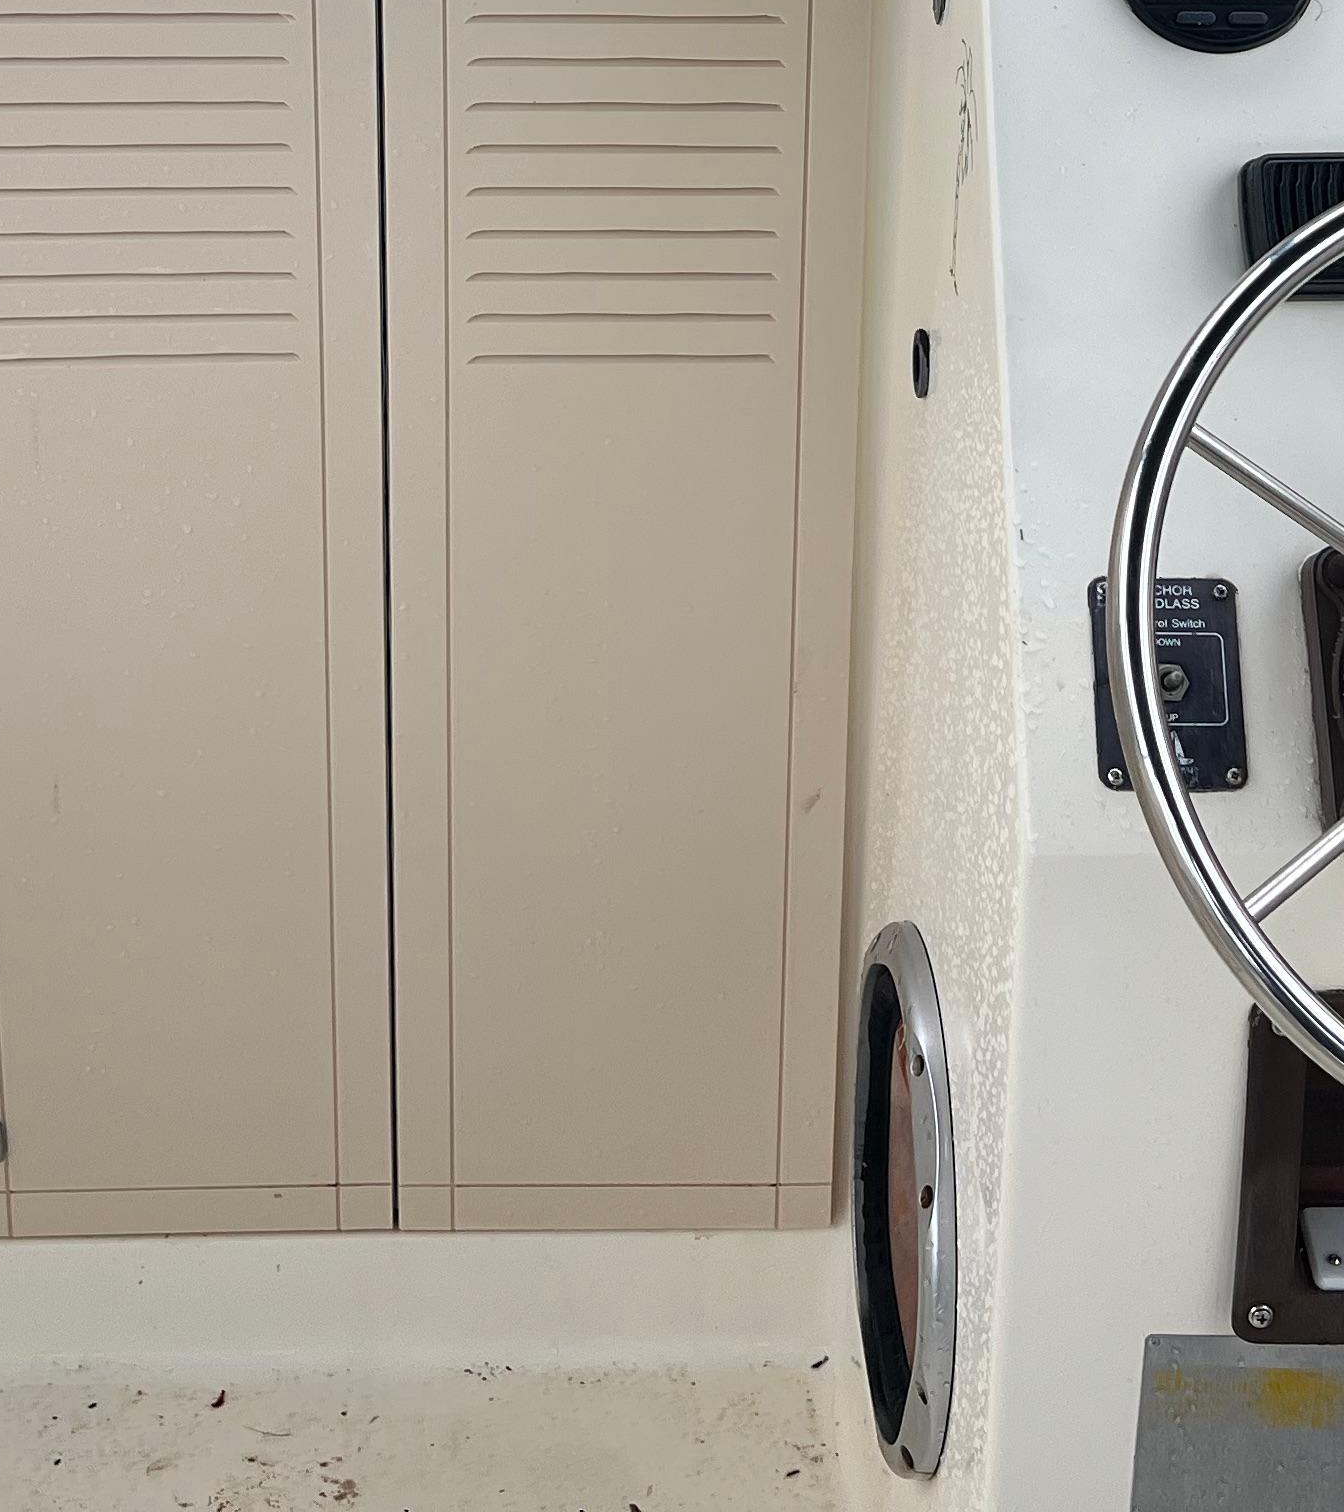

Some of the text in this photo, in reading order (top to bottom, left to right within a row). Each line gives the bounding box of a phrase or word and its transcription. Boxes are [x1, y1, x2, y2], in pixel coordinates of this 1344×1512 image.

[1155, 584, 1193, 596] CHOR
[1155, 598, 1200, 609] DLASS
[1171, 618, 1206, 628] Switch
